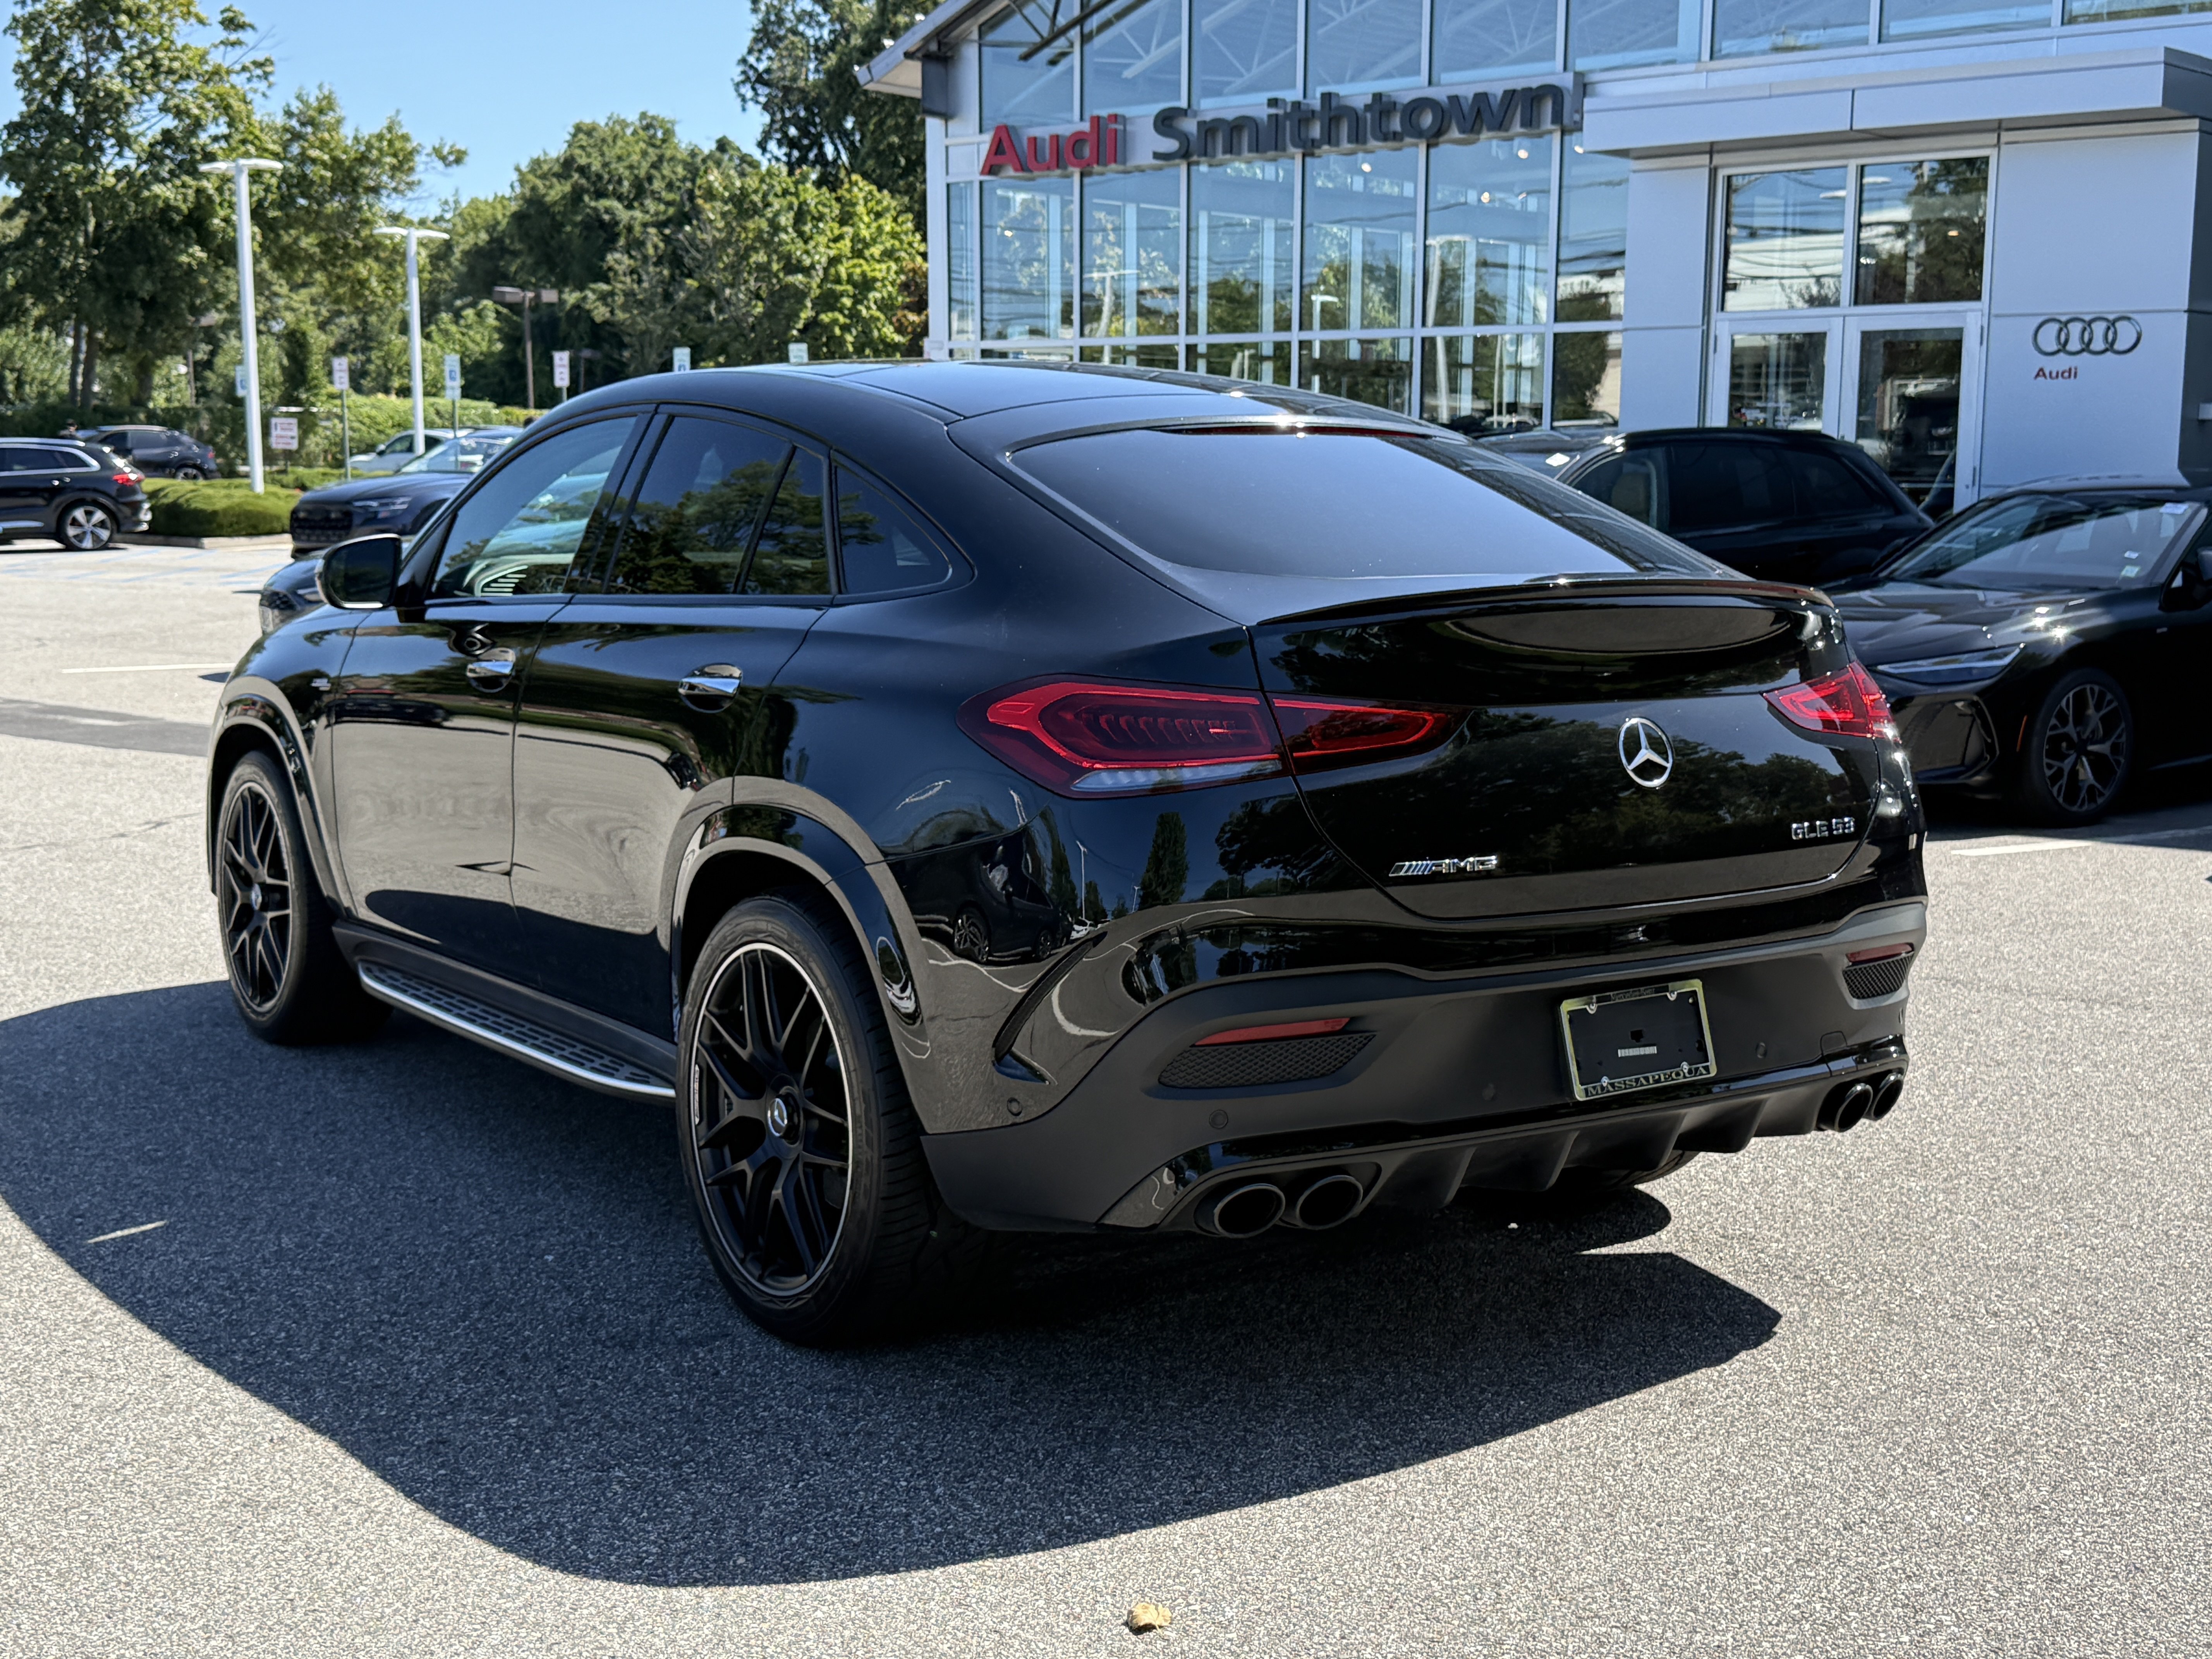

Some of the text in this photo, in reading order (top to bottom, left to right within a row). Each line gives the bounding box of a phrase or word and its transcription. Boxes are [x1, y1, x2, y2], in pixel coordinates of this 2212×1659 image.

[980, 83, 1565, 175] Audi Smithtown
[2034, 366, 2078, 380] Audi
[1791, 817, 1855, 840] GLE 53
[1424, 855, 1497, 875] AMG
[1588, 1066, 1707, 1096] MASSAPEQUA
